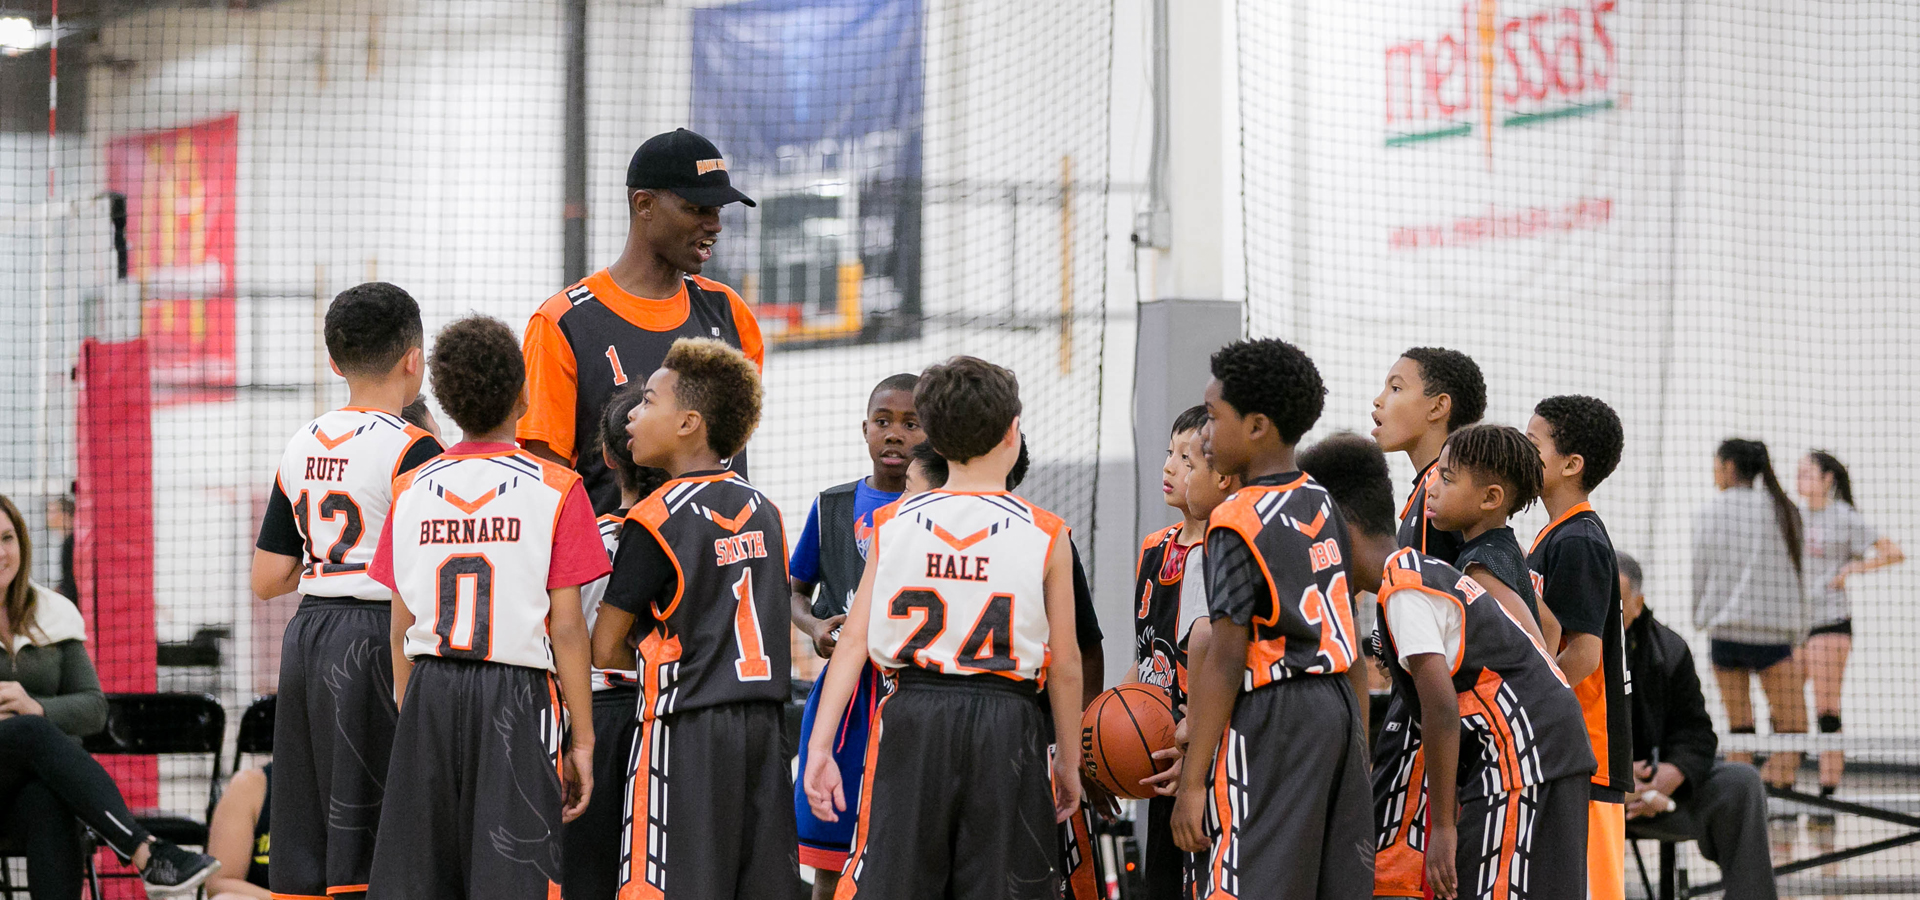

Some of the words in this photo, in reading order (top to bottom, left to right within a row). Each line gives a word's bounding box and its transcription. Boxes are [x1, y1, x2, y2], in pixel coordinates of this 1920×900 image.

[605, 345, 628, 386] 1
[304, 456, 349, 482] RUFF
[293, 488, 368, 579] 12
[419, 517, 521, 546] BERNARD
[714, 531, 767, 567] SMITH
[926, 552, 990, 582] HALE
[1308, 538, 1342, 573] BO
[433, 552, 495, 661] 0
[732, 566, 772, 682] 1
[887, 586, 1022, 677] 24
